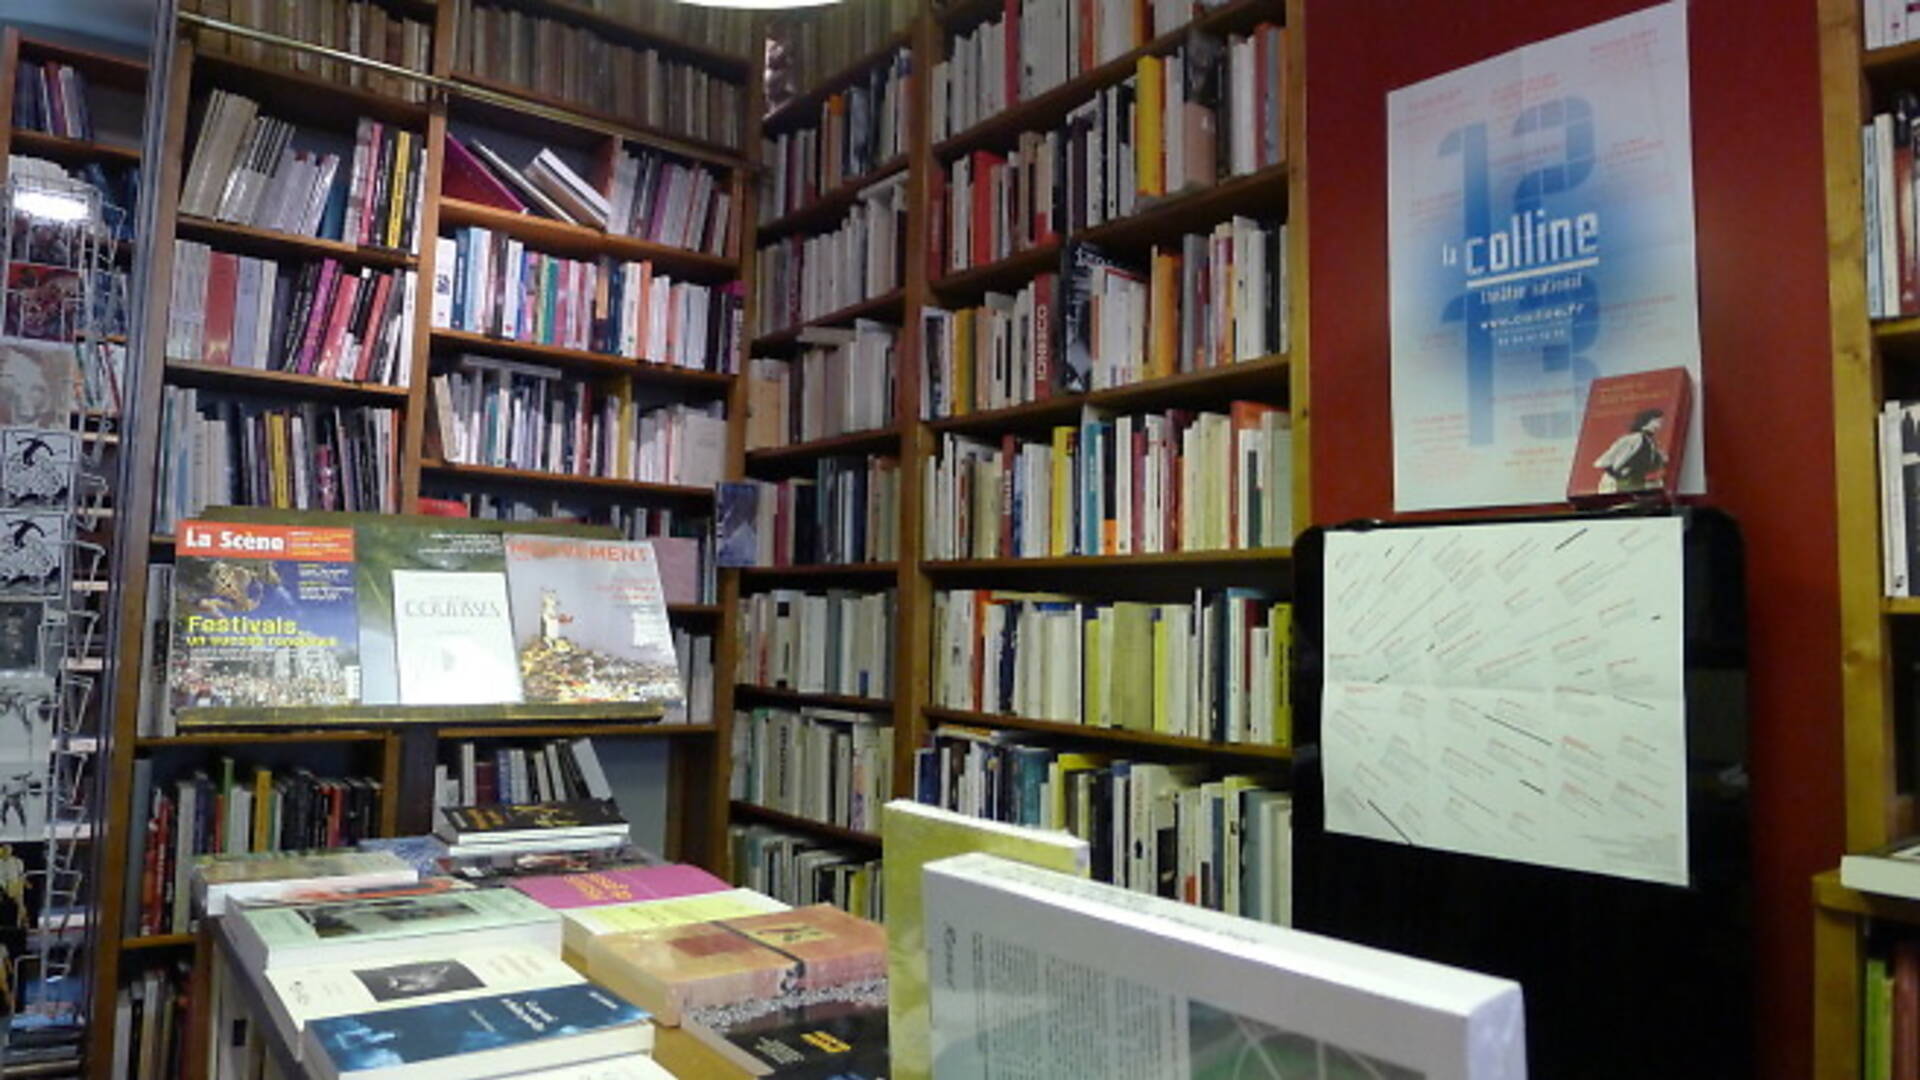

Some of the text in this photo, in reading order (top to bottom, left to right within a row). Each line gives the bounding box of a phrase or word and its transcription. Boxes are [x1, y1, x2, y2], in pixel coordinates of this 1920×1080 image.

[1464, 209, 1600, 277] colline
[186, 527, 212, 548] La
[220, 529, 284, 551] Scène
